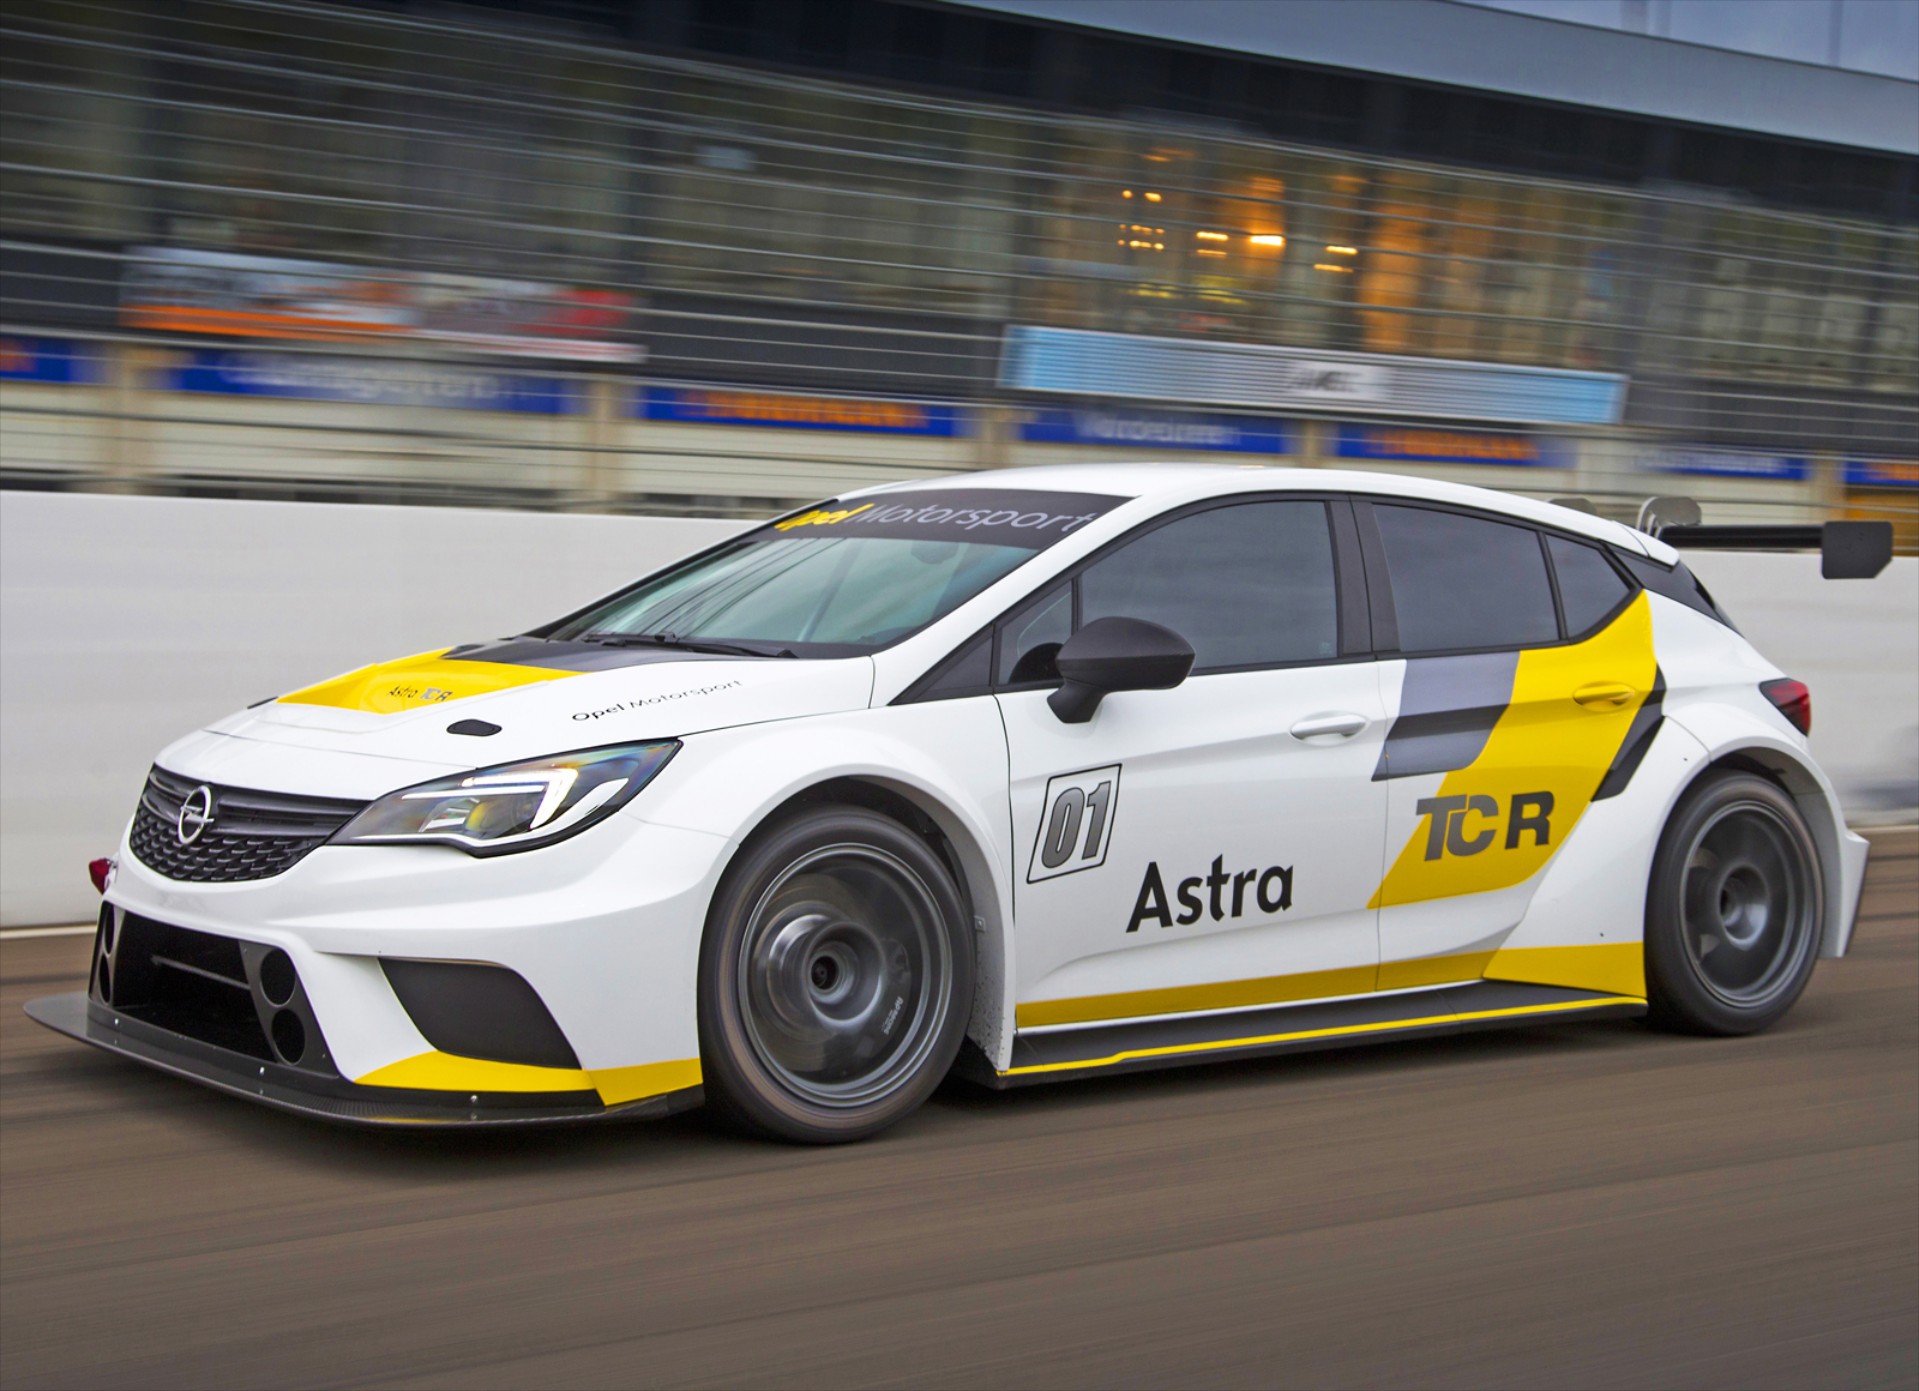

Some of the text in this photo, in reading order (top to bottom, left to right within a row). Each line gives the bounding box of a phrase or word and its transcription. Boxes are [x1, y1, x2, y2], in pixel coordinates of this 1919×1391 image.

[843, 503, 1099, 532] Motorsport
[572, 679, 743, 721] Opel Motorsport
[1041, 780, 1112, 869] 01
[1416, 791, 1556, 862] TCR
[1126, 853, 1294, 933] Astra
